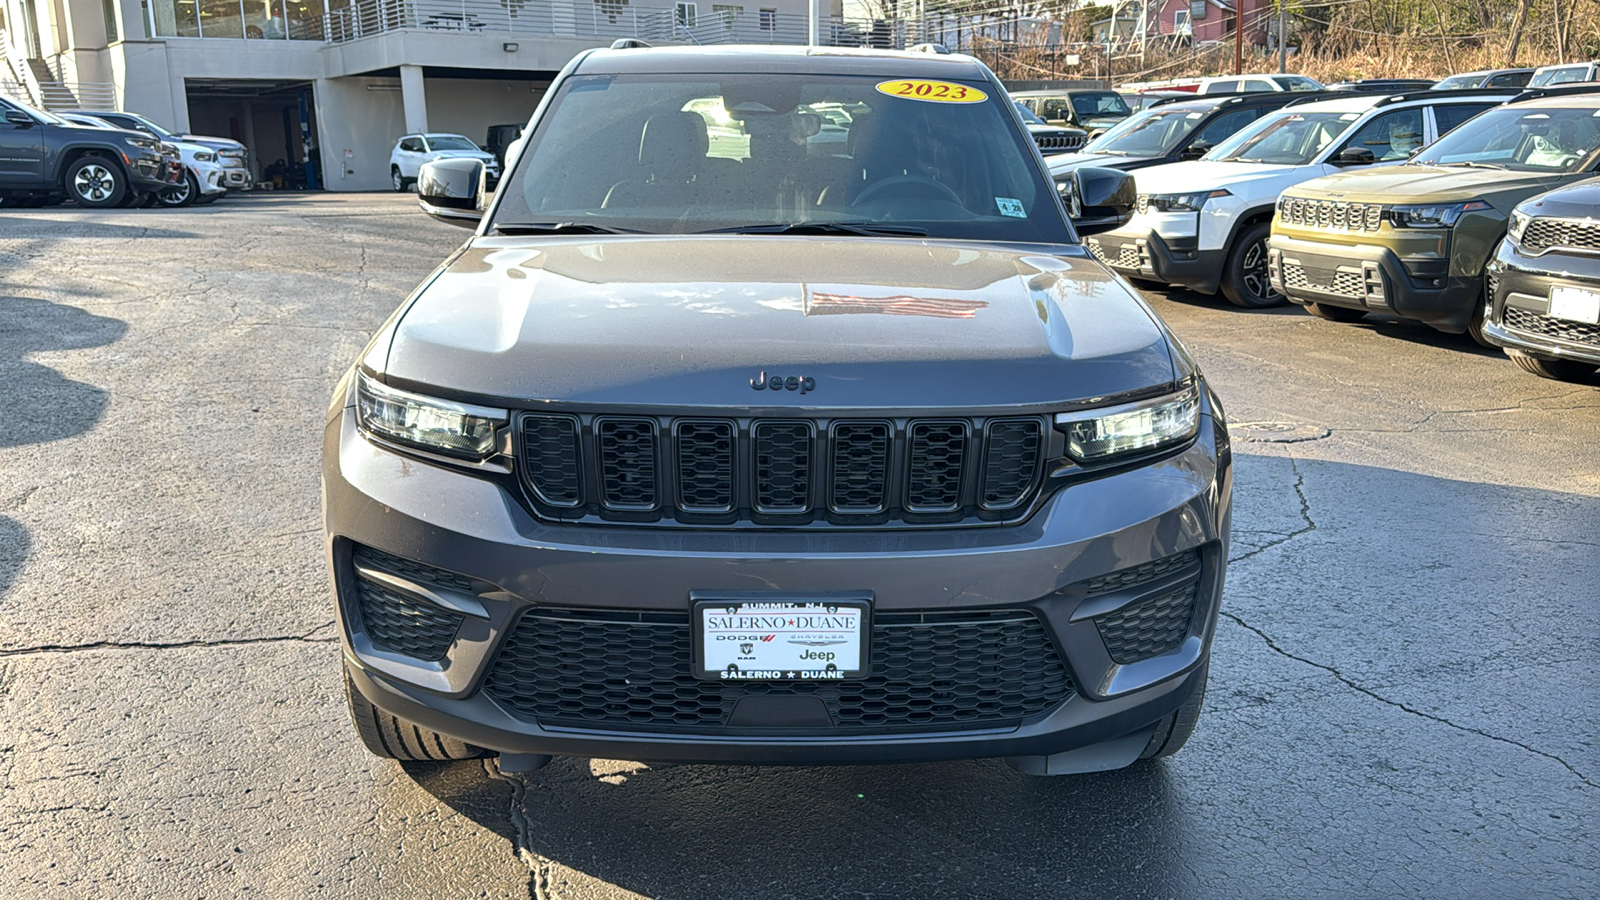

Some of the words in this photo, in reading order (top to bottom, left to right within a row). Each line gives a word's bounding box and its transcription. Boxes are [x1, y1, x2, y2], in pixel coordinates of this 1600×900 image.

[896, 82, 968, 99] 2023
[749, 371, 816, 395] Jeep
[708, 616, 786, 629] SALERNO
[796, 616, 856, 629] DUANE
[799, 649, 836, 662] Jeep
[720, 670, 782, 679] SALERNO
[801, 670, 845, 679] DUANE
